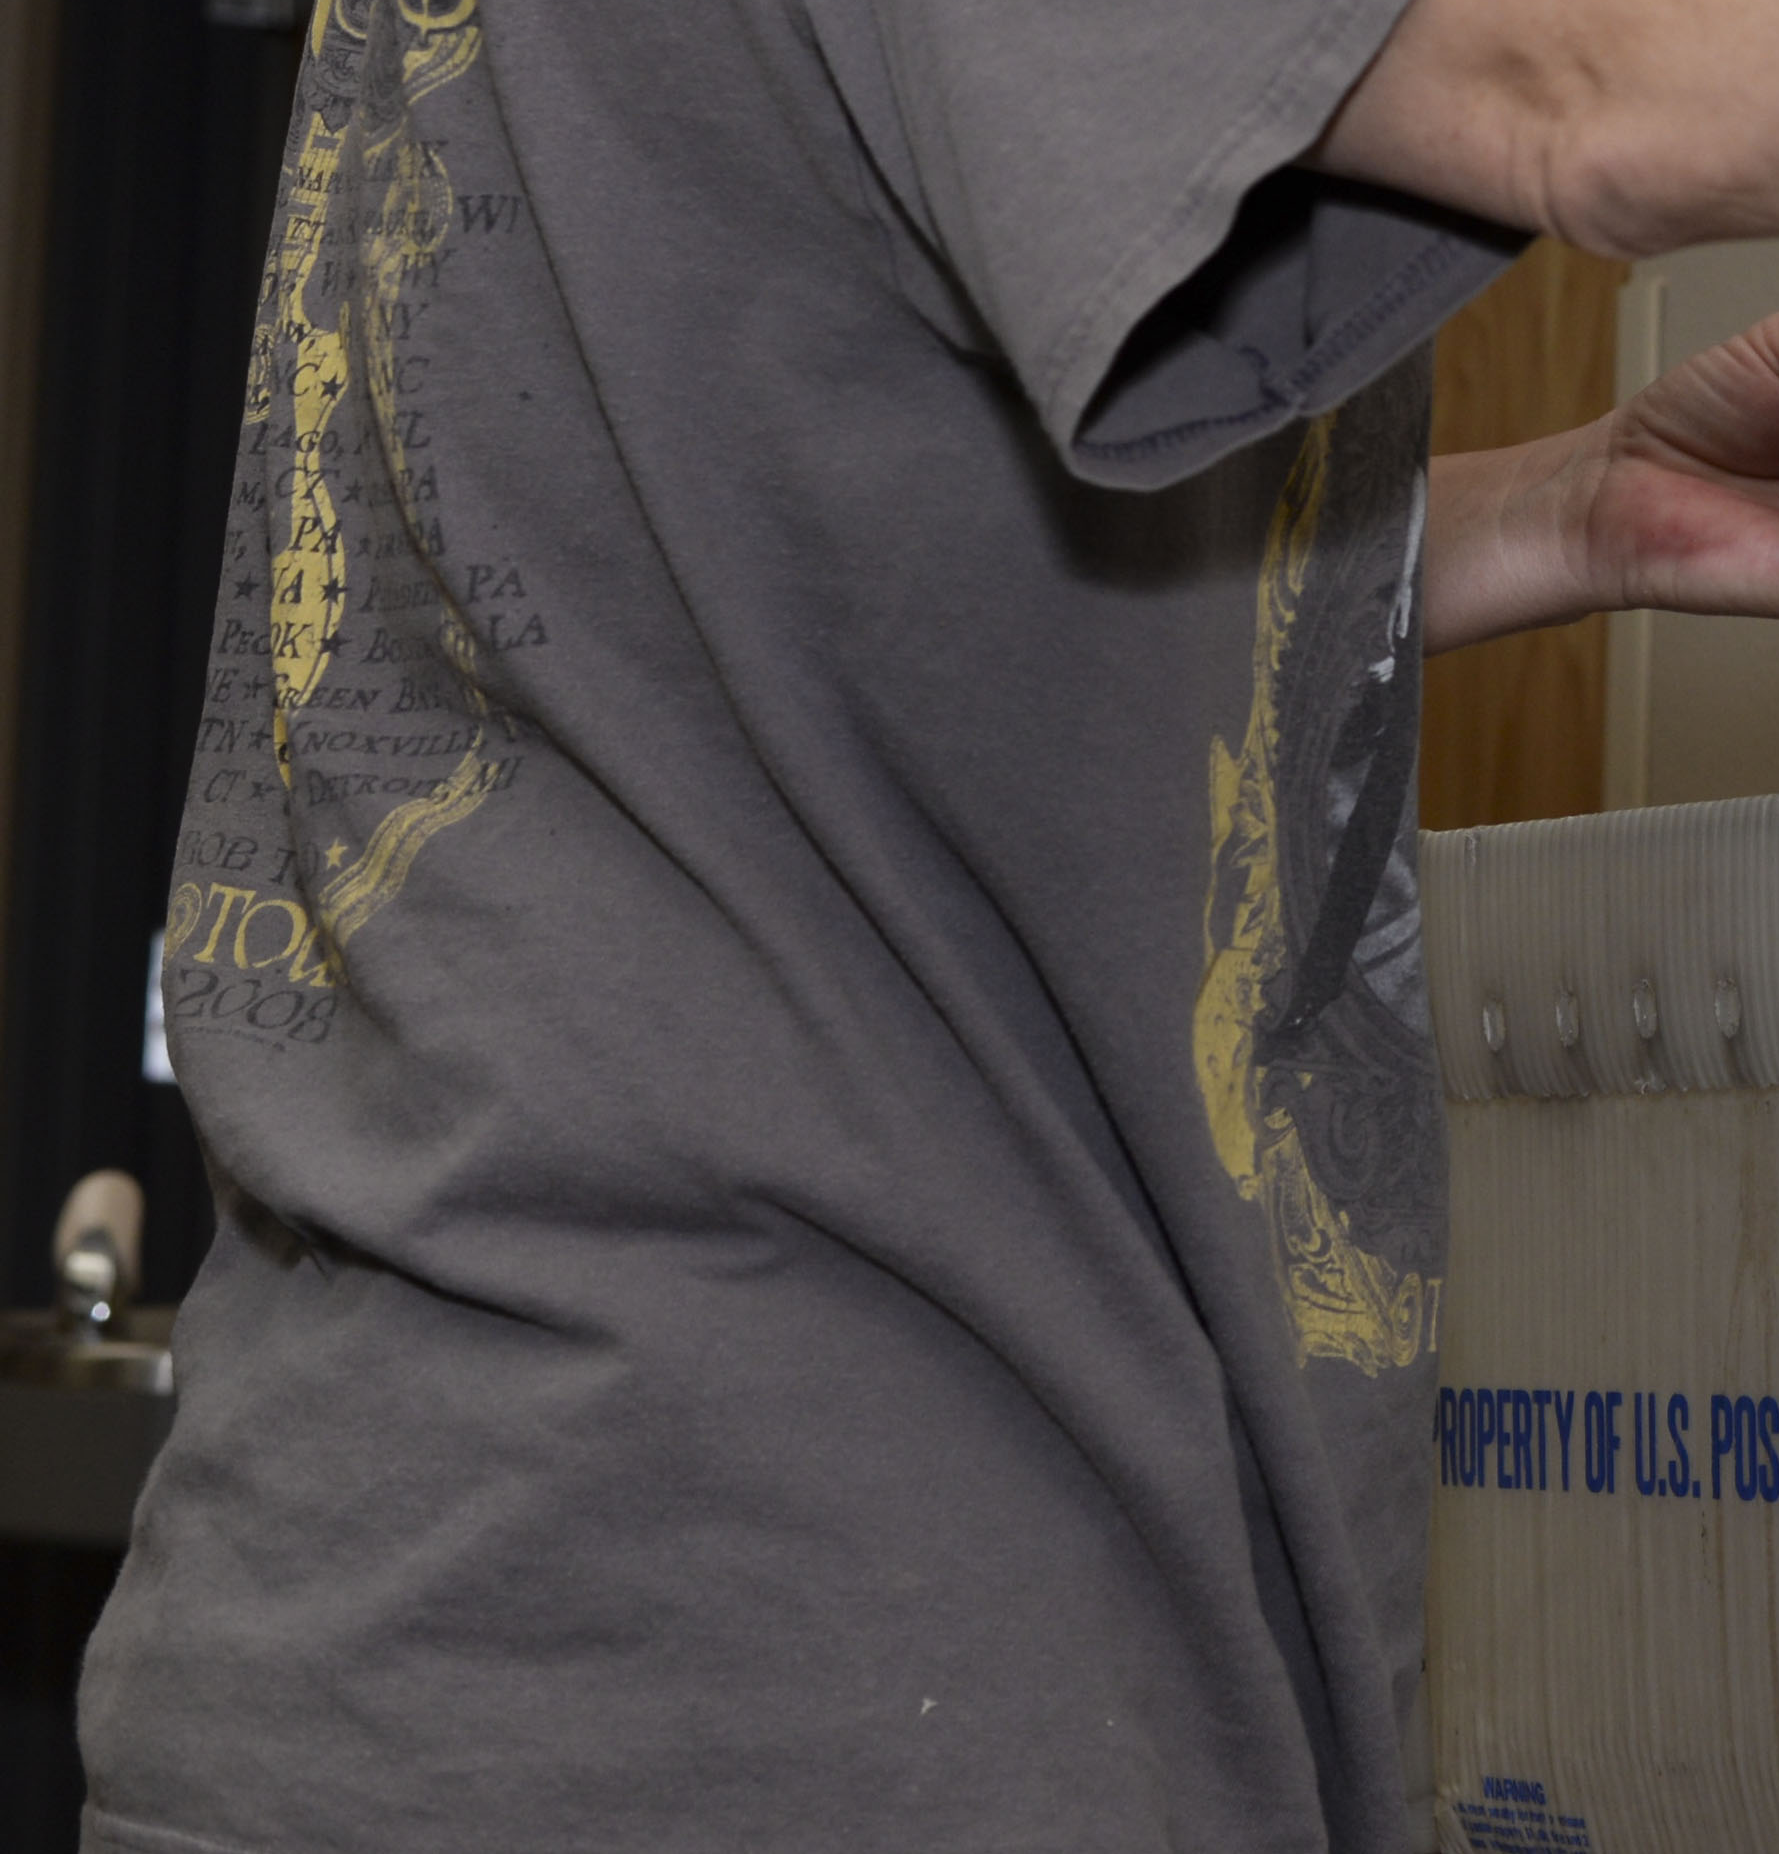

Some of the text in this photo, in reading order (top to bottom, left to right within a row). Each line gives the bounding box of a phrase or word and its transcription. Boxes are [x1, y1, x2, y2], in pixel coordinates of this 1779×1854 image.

[464, 563, 527, 607] PA
[174, 968, 341, 1044] 2008
[1432, 1386, 1575, 1492] ROPERTY
[1584, 1390, 1622, 1494] OF
[1634, 1393, 1701, 1500] U.S.
[1483, 1776, 1546, 1806] WARNING
